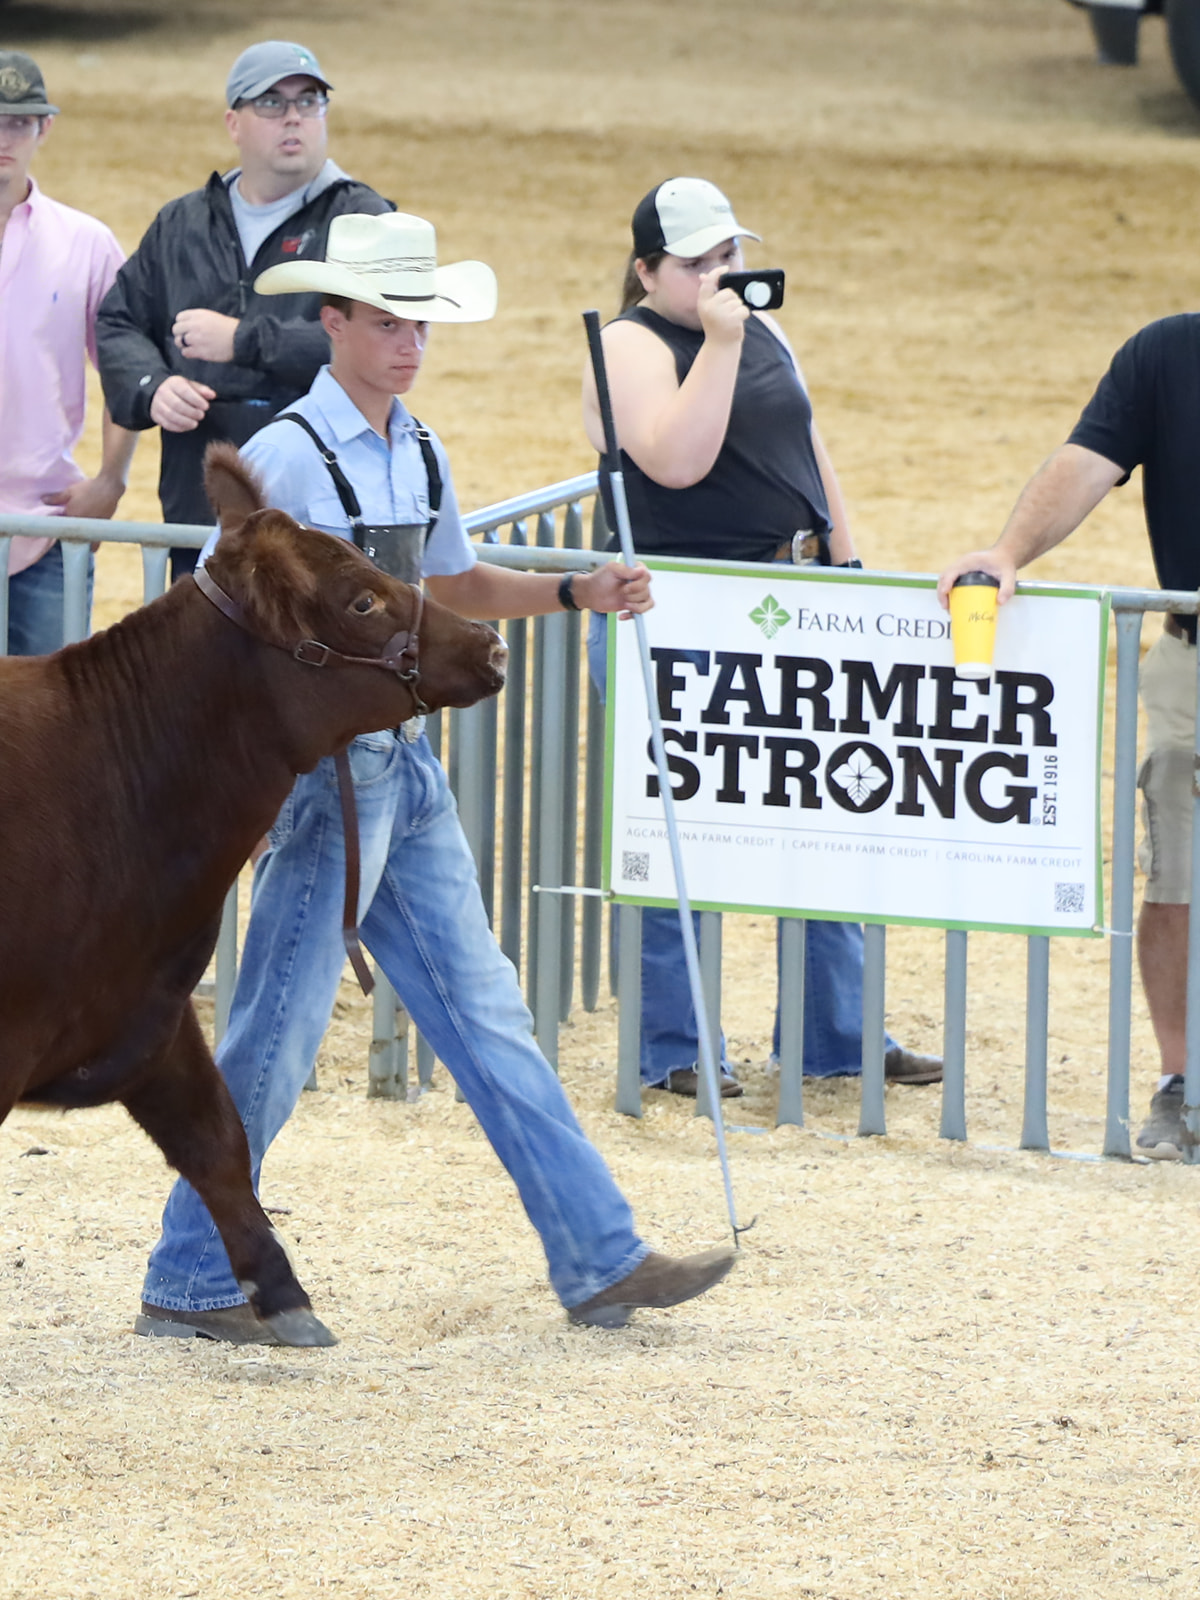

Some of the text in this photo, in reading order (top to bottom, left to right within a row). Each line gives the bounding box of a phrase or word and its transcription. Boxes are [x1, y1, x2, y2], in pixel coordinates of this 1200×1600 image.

[797, 608, 952, 640] FARM CREDI
[650, 646, 1057, 747] FARMER
[645, 728, 1038, 826] STRONG
[1043, 754, 1058, 787] 1916
[626, 827, 1082, 868] AGCAROINA FARM CREDIT CAPE FEAR FARM CREDIT CAROLINA FARM CREDIT
